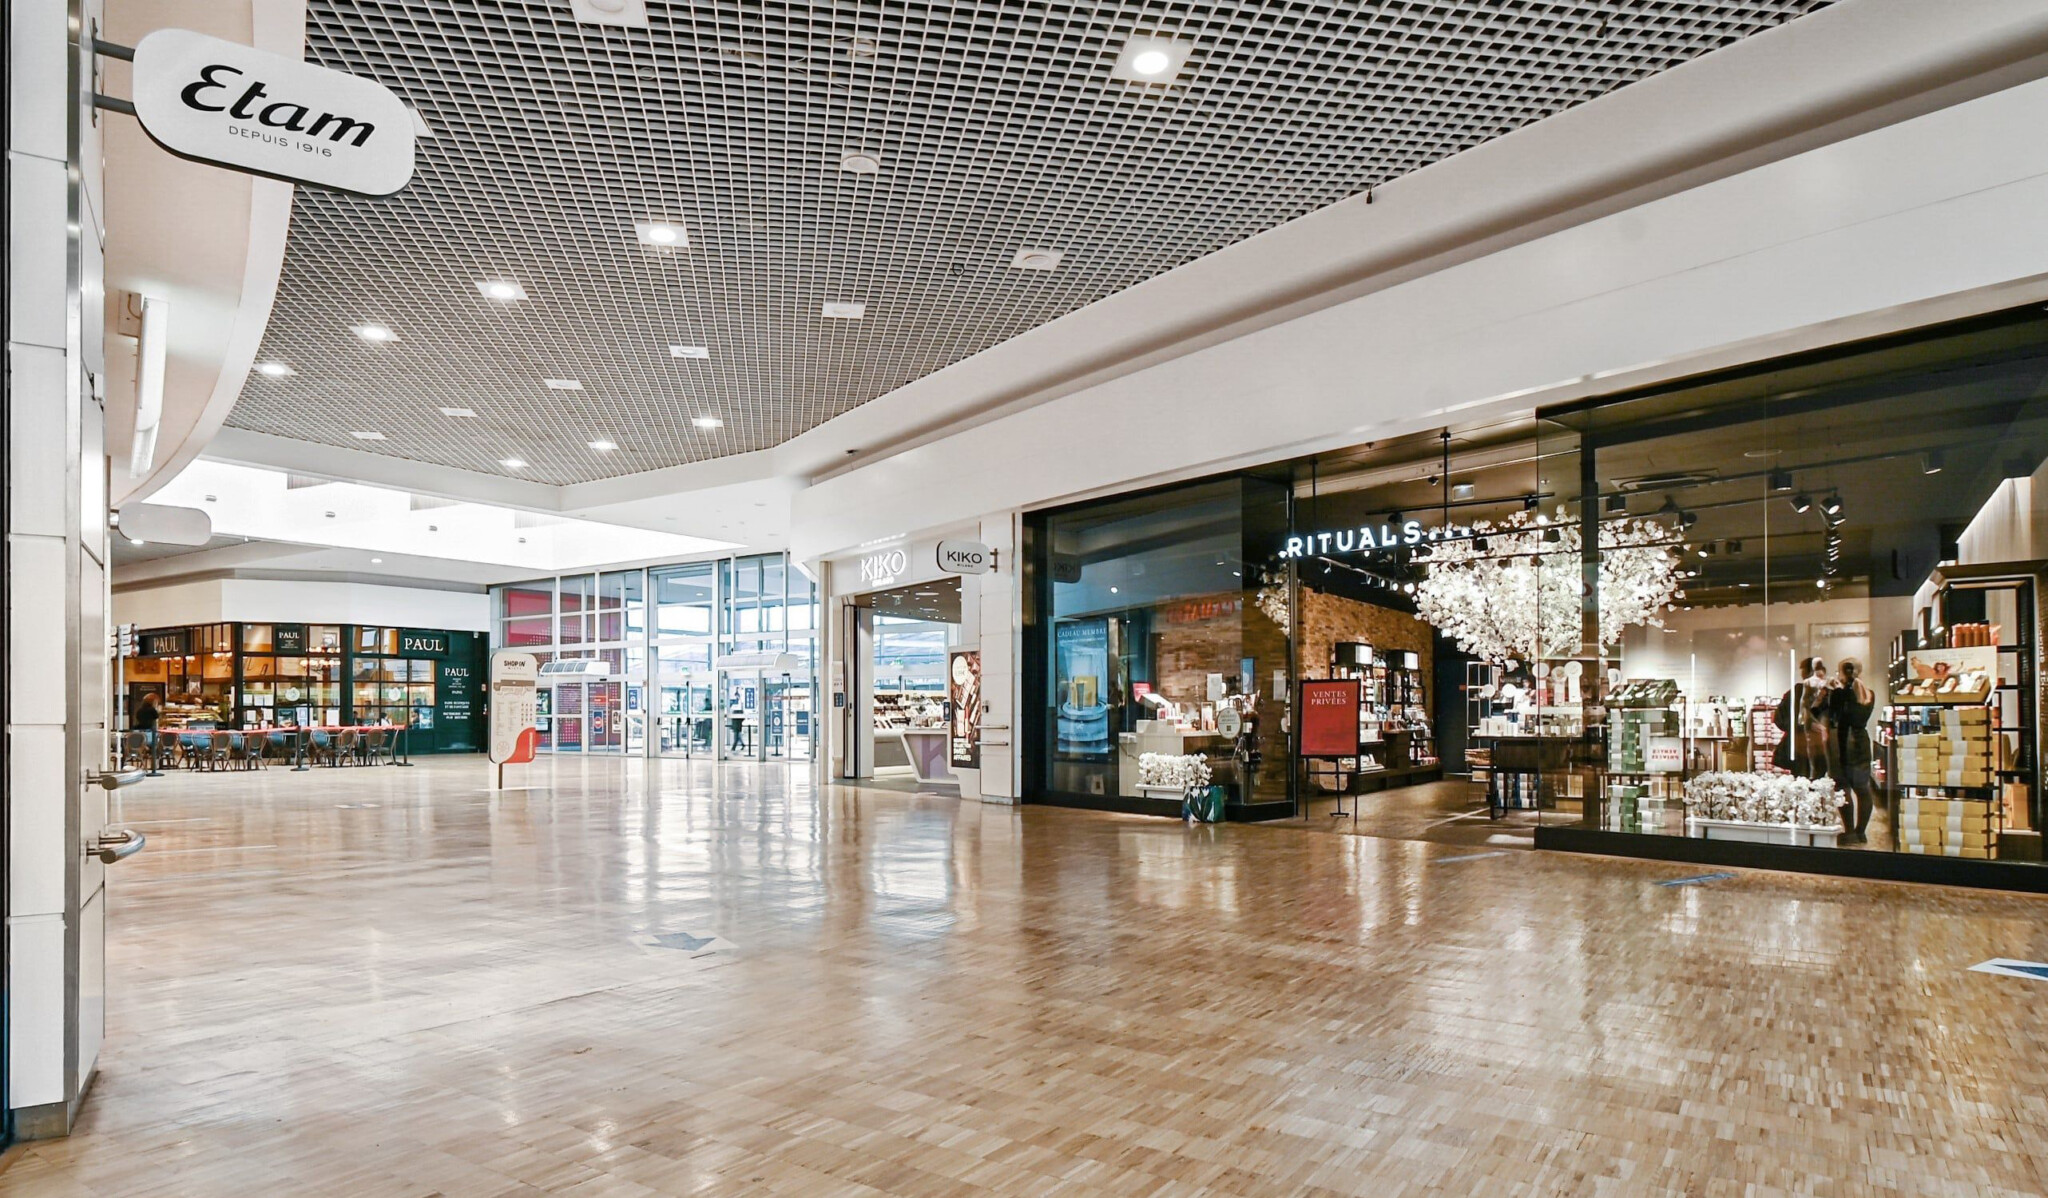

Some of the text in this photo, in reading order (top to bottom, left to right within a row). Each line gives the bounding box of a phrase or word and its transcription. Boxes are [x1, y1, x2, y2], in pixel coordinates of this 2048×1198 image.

[180, 64, 375, 148] Etam
[229, 125, 332, 158] DEPUIS 1916
[947, 550, 982, 564] KIKO
[861, 549, 906, 582] KIKO
[278, 631, 300, 639] PAUL
[153, 636, 179, 653] PAUL
[404, 637, 444, 652] PAUL
[444, 667, 469, 677] PAUL
[1312, 690, 1347, 698] VENTES
